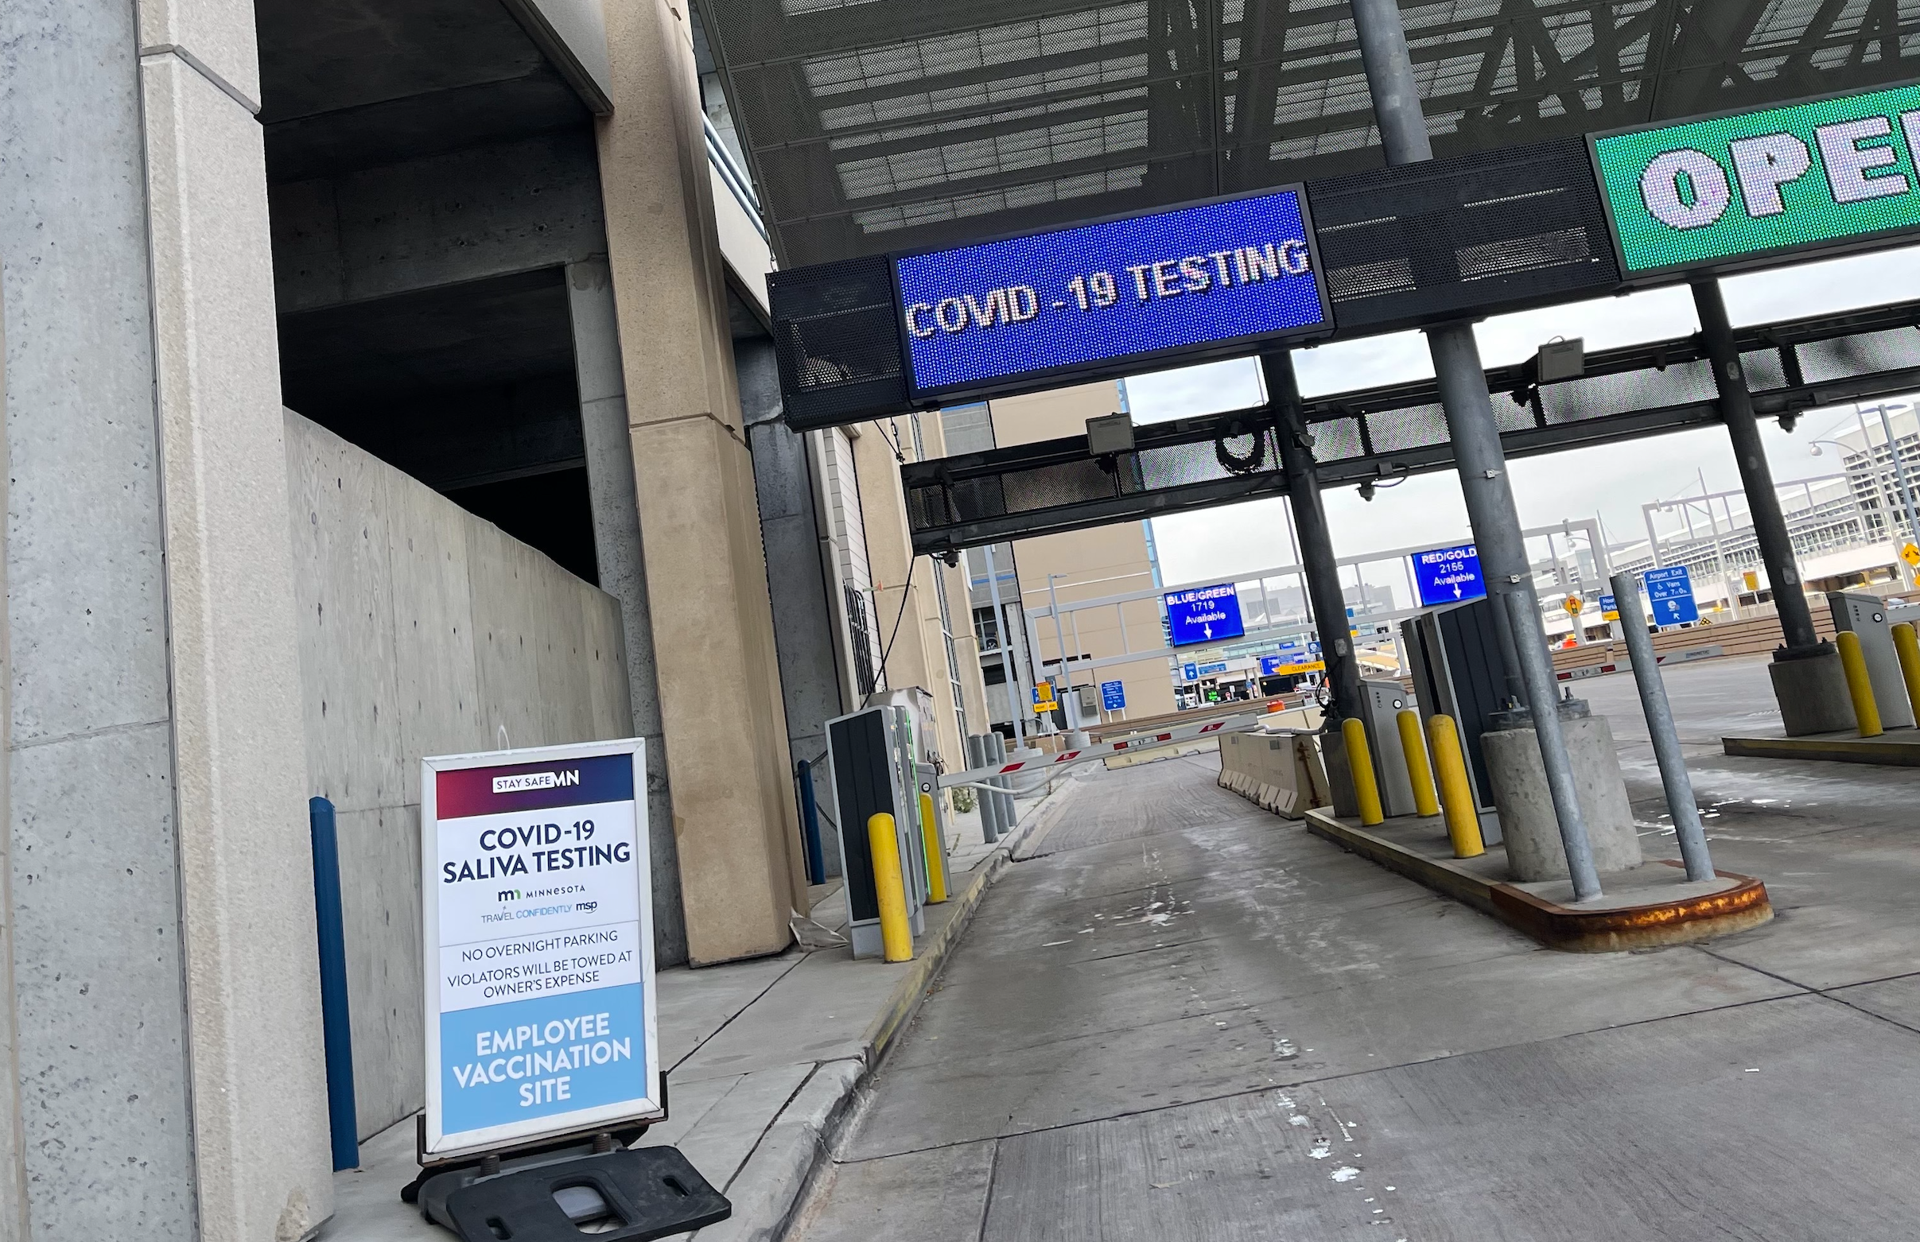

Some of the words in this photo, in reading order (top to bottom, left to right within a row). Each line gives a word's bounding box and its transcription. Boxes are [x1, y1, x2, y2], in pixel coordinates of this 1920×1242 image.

[1640, 107, 1920, 231] OPE
[905, 283, 1039, 338] COVID
[1051, 271, 1119, 311] -19
[1127, 237, 1311, 301] TESTING
[1421, 548, 1477, 565] RED/GOLD
[1433, 572, 1476, 587] Available
[1650, 571, 1669, 580] Airport
[1167, 587, 1235, 605] BLUE/GREEN
[1190, 601, 1215, 612] 1719
[1185, 611, 1227, 626] Available
[1291, 663, 1321, 672] CLEARANCE
[496, 779, 522, 790] STAY
[525, 775, 550, 787] SAFE
[551, 769, 580, 788] MN
[479, 819, 595, 851] COVID-19
[443, 853, 529, 884] SALIVA
[532, 842, 631, 873] TESTING
[481, 908, 514, 923] TRAVEL
[515, 904, 573, 919] CONFIDENTLY
[575, 901, 598, 914] msp
[462, 948, 483, 962] NO
[485, 937, 561, 957] OVERNIGHT
[563, 930, 618, 948] PARKING
[447, 966, 520, 988] VIOLATORS
[522, 962, 551, 976] WILL
[553, 959, 569, 972] BE
[571, 952, 616, 970] TOWED
[618, 950, 633, 963] AT
[483, 978, 542, 998] OWNER'S
[545, 970, 600, 990] EXPENSE
[476, 1012, 610, 1057] EMPLOYEE
[452, 1037, 631, 1089] VACCINATION
[519, 1076, 571, 1107] SITE
